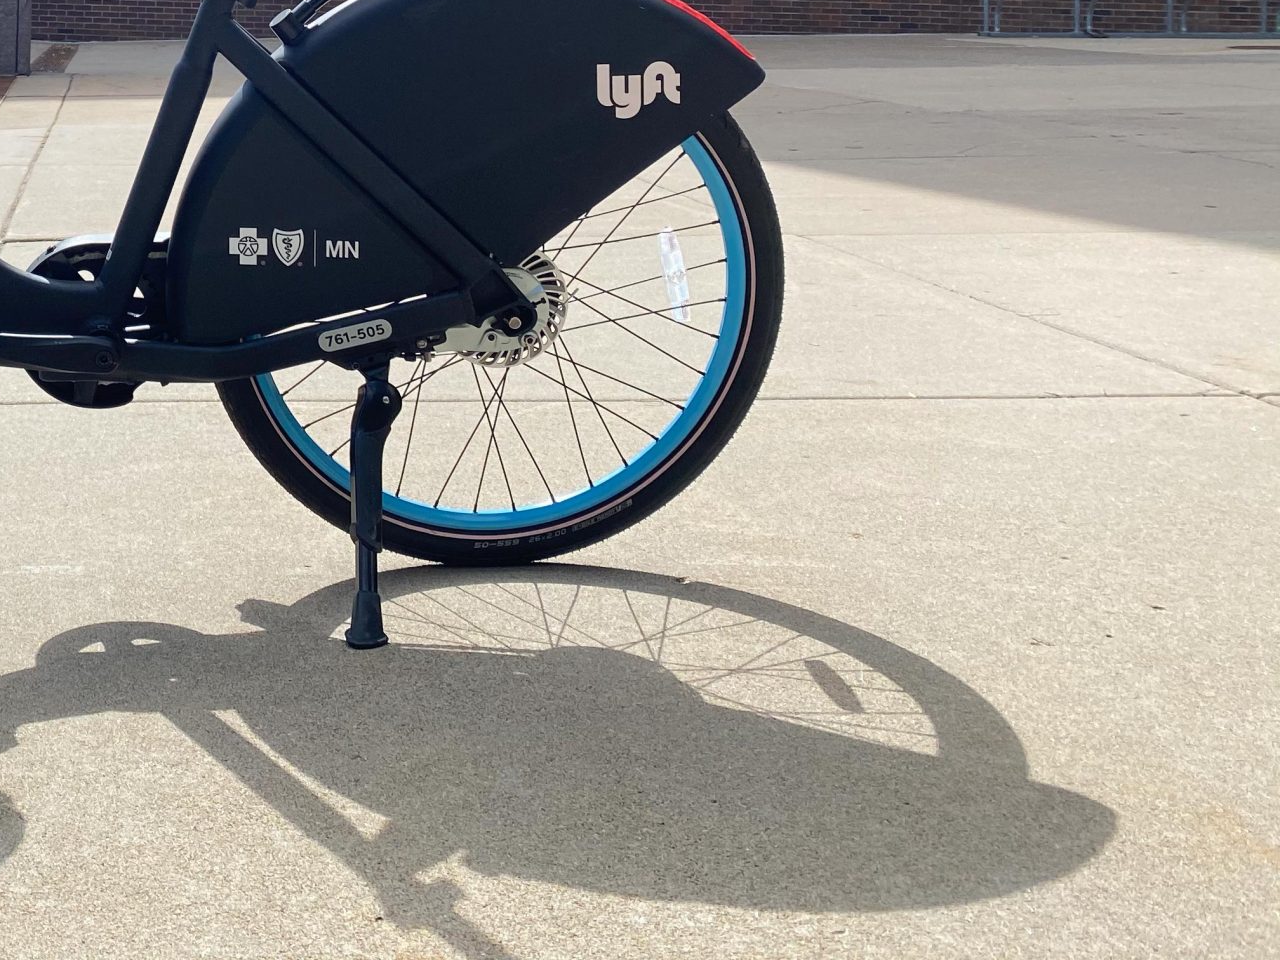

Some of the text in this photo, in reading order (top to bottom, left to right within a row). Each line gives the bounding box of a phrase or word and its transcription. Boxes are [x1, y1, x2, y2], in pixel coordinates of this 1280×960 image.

[596, 60, 681, 119] lyft
[325, 239, 360, 259] MN
[324, 324, 386, 348] 761-505
